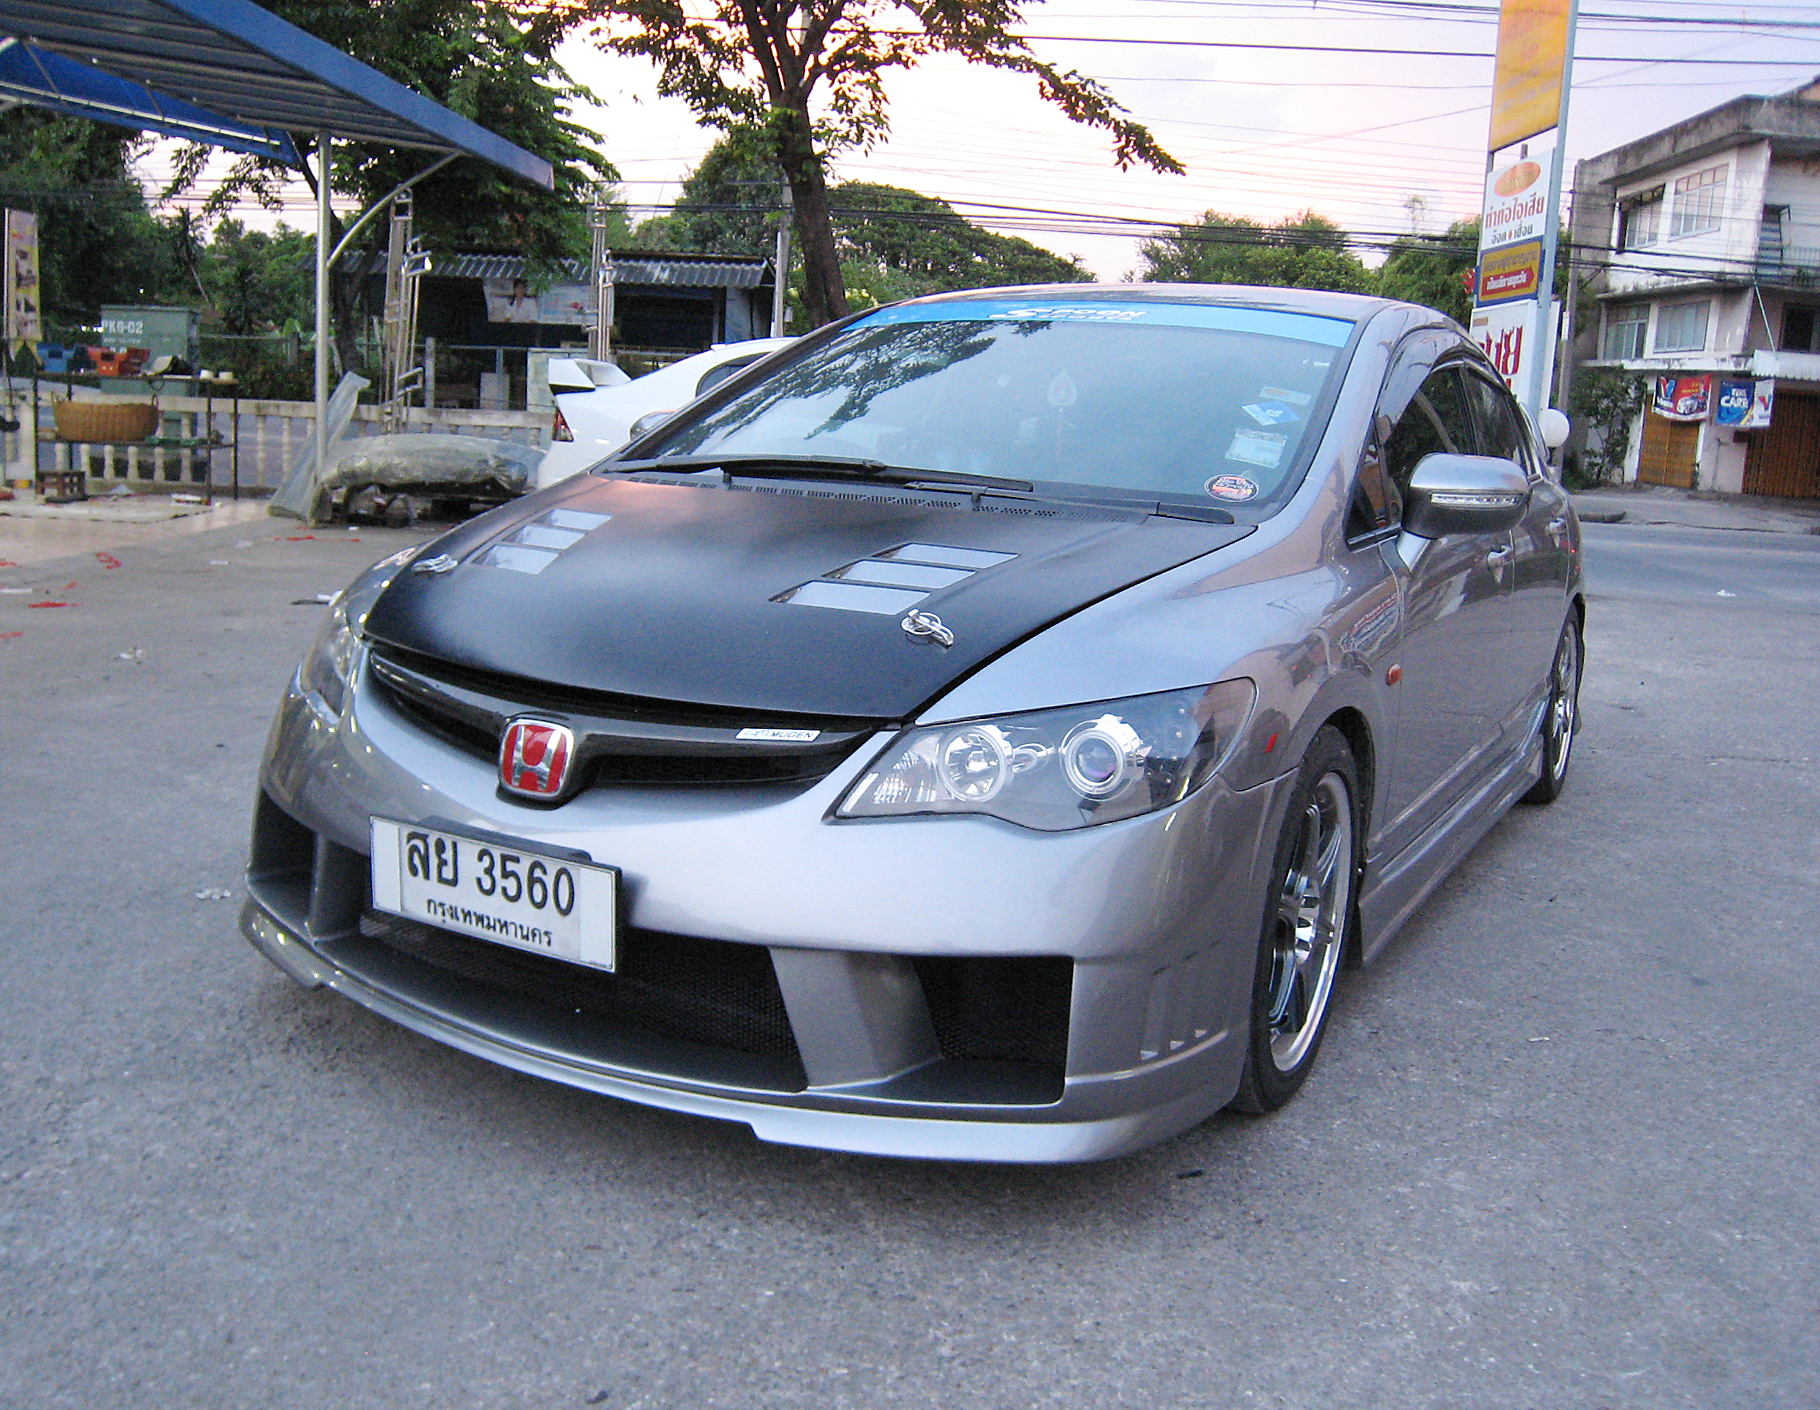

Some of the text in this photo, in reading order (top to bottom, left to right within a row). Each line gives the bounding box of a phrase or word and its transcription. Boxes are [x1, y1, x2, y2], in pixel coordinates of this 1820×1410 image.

[1485, 192, 1545, 229] ทำท่อไอเสีย
[769, 730, 814, 739] MUGEN
[405, 831, 576, 917] สย 3560
[426, 898, 553, 947] กรุงเทพมหานคร
